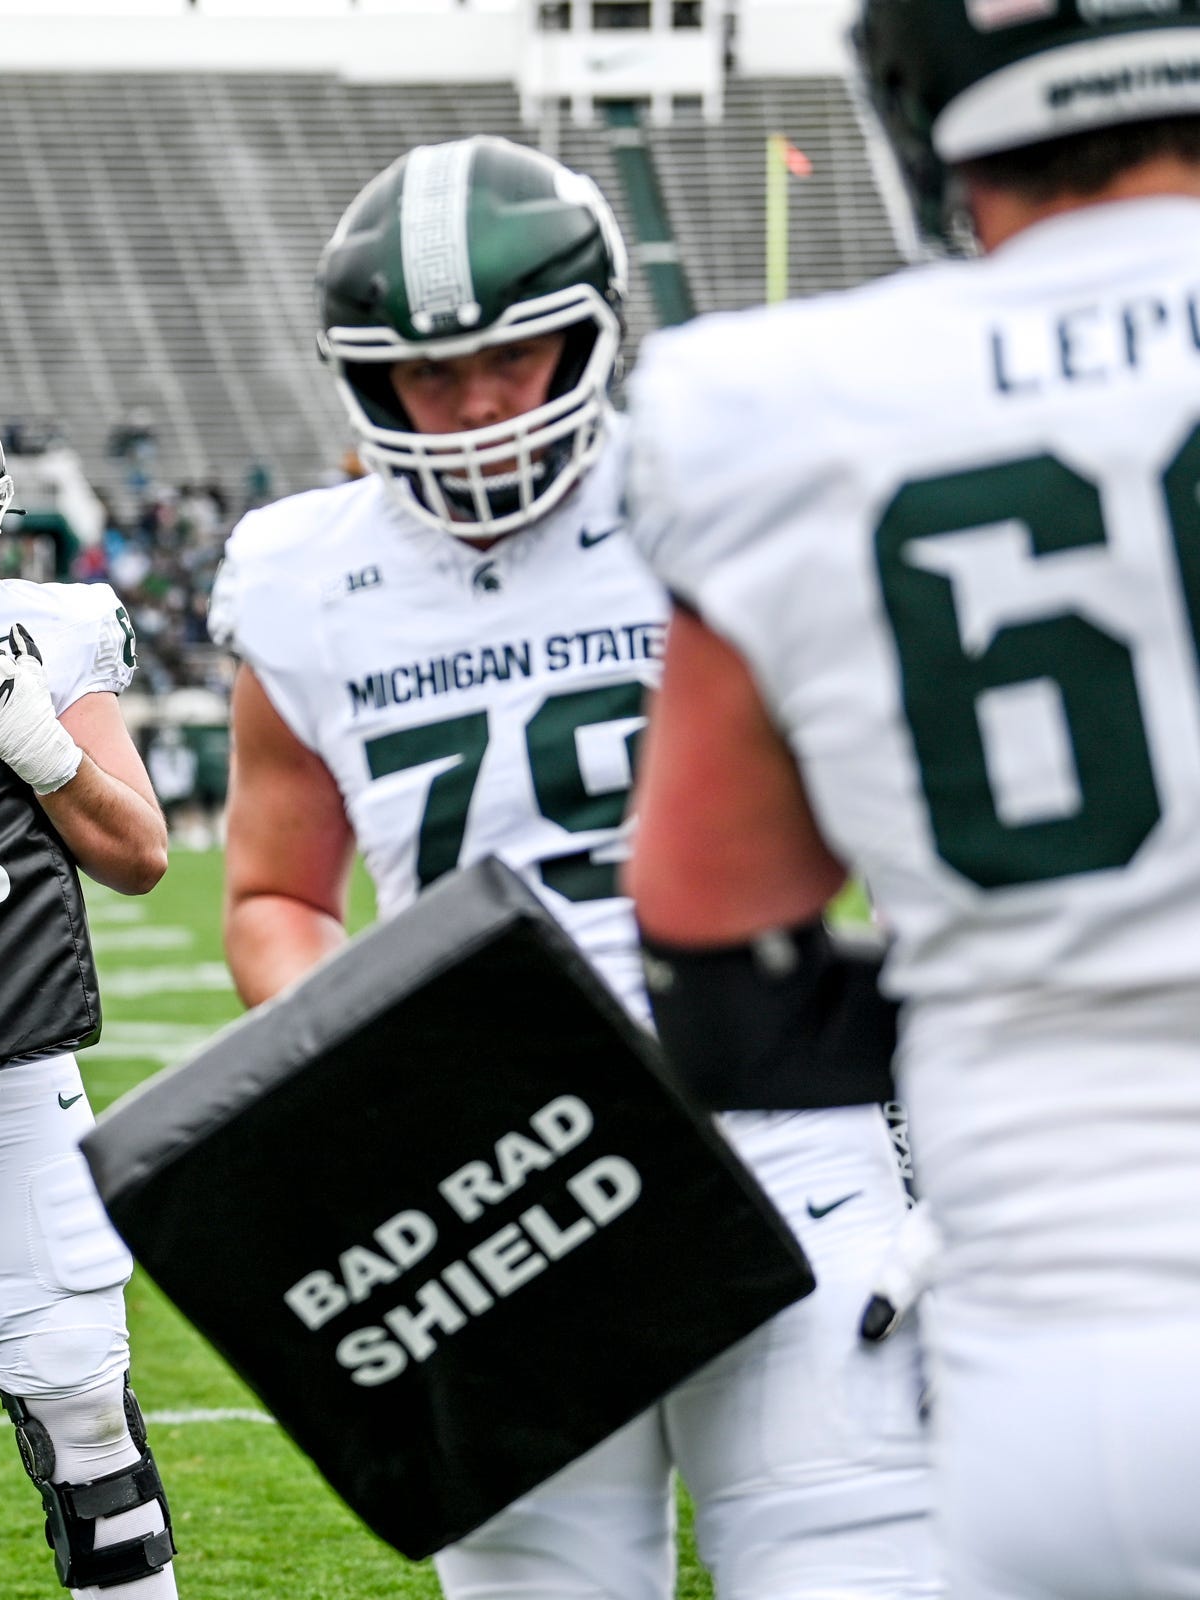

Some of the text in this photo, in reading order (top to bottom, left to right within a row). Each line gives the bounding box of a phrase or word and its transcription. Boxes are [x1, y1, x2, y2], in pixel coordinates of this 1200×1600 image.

[347, 623, 668, 718] MICHIGAN STATE
[874, 418, 1200, 889] 6
[283, 1093, 595, 1332] BAD RAD
[335, 1154, 642, 1387] SHIELD
